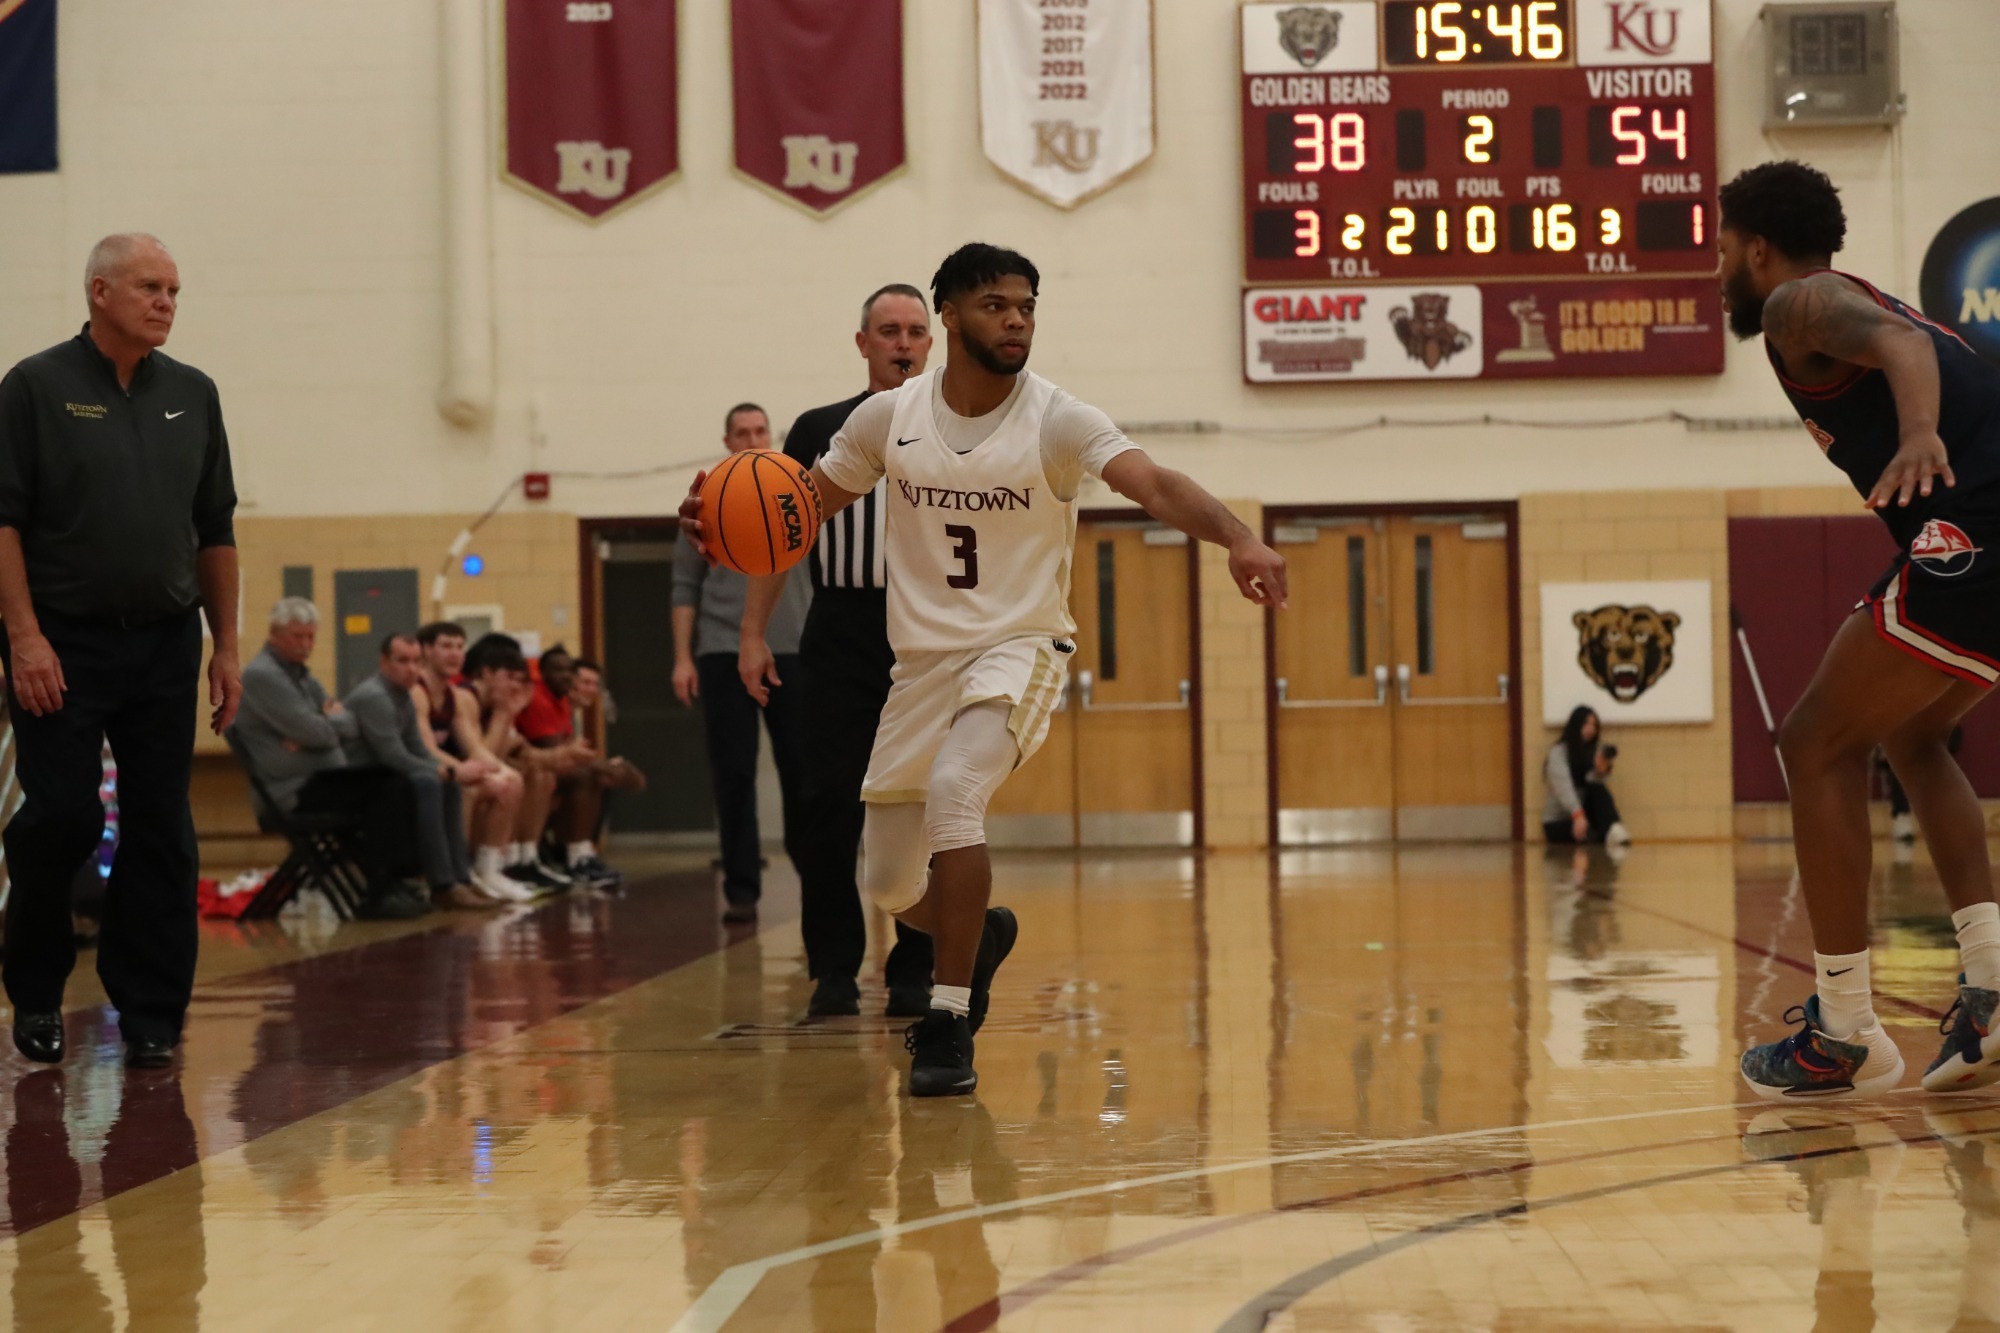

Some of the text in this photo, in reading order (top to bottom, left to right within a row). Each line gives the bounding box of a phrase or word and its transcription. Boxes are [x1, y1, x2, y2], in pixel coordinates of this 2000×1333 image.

[1041, 14, 1087, 31] 2012
[1416, 2, 1563, 61] 15:46
[1605, 3, 1682, 56] KU
[1042, 37, 1085, 54] 2017
[1040, 60, 1085, 77] 2021
[1586, 68, 1693, 98] VISITOR
[1038, 83, 1088, 100] 2022
[1250, 75, 1390, 106] GOLDEN BEARS
[1441, 88, 1509, 109] PERIOD
[1030, 118, 1102, 175] KU
[1293, 112, 1366, 173] 38
[1464, 114, 1494, 163] 2
[1611, 106, 1687, 165] 54
[554, 141, 631, 199] KU
[781, 134, 859, 193] KU
[1258, 181, 1320, 202] FOULS
[1393, 178, 1440, 200] PLYR
[1456, 177, 1504, 198] FOUL
[1526, 175, 1562, 198] PTS
[1641, 172, 1702, 194] FOULS
[1294, 209, 1321, 257] 3
[1341, 213, 1366, 250] 2
[1466, 205, 1496, 253] 0
[1532, 203, 1576, 251] 16
[1600, 208, 1621, 245] 3
[1692, 204, 1703, 245] 1
[1328, 256, 1380, 278] T.O.L.
[1585, 252, 1637, 274] T.O.L.
[1254, 294, 1366, 323] GIANT
[1959, 287, 2000, 323] N
[1560, 327, 1645, 353] GOLDEN
[897, 478, 1035, 512] KUTZTOWN
[776, 492, 802, 552] NCAA
[944, 523, 979, 590] 3
